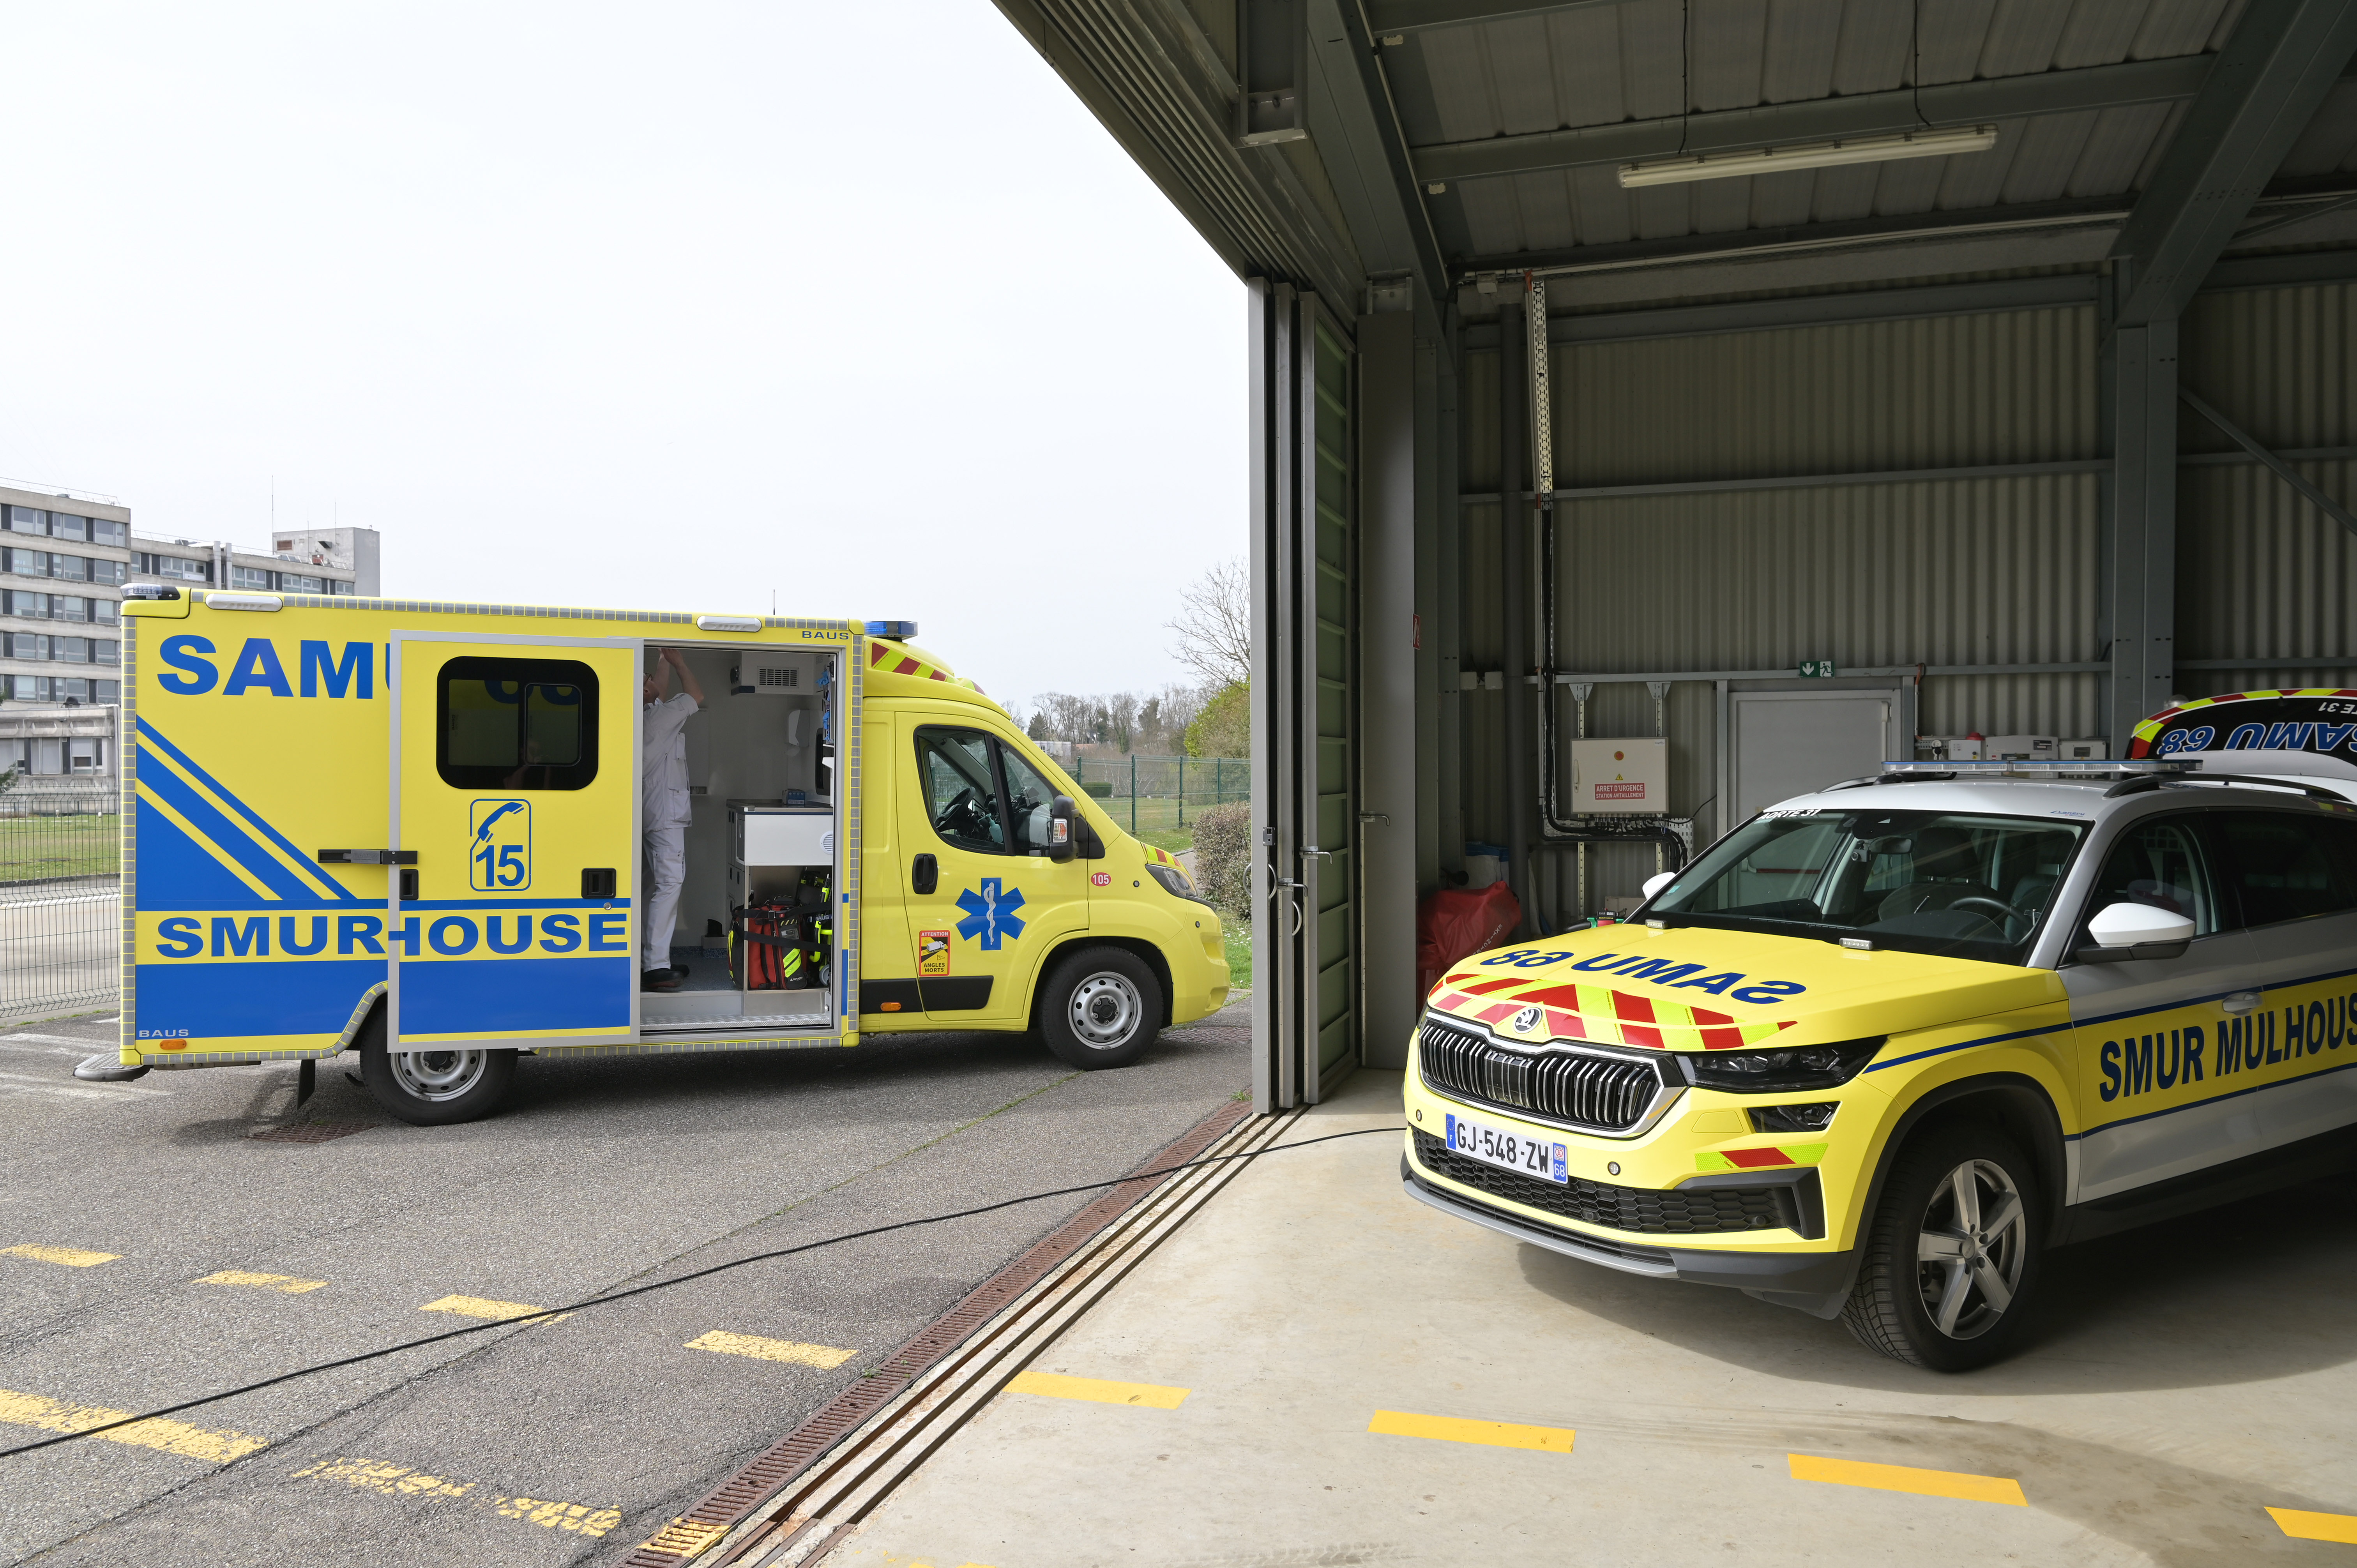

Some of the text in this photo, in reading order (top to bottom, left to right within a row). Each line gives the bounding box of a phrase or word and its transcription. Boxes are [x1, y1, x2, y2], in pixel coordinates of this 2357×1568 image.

[802, 630, 849, 640] BAUS
[157, 634, 390, 699] SAM
[2318, 702, 2340, 712] 31
[2157, 722, 2357, 755] AMU 68
[1756, 810, 1804, 820] AORTE
[475, 845, 525, 887] 15
[1093, 874, 1110, 885] 105
[156, 915, 386, 958] SMUR
[139, 1029, 189, 1037] BAUS
[2099, 1026, 2204, 1102] SMUR
[1457, 1123, 1548, 1173] GJ-548-ZW
[1554, 1163, 1565, 1177] 68
